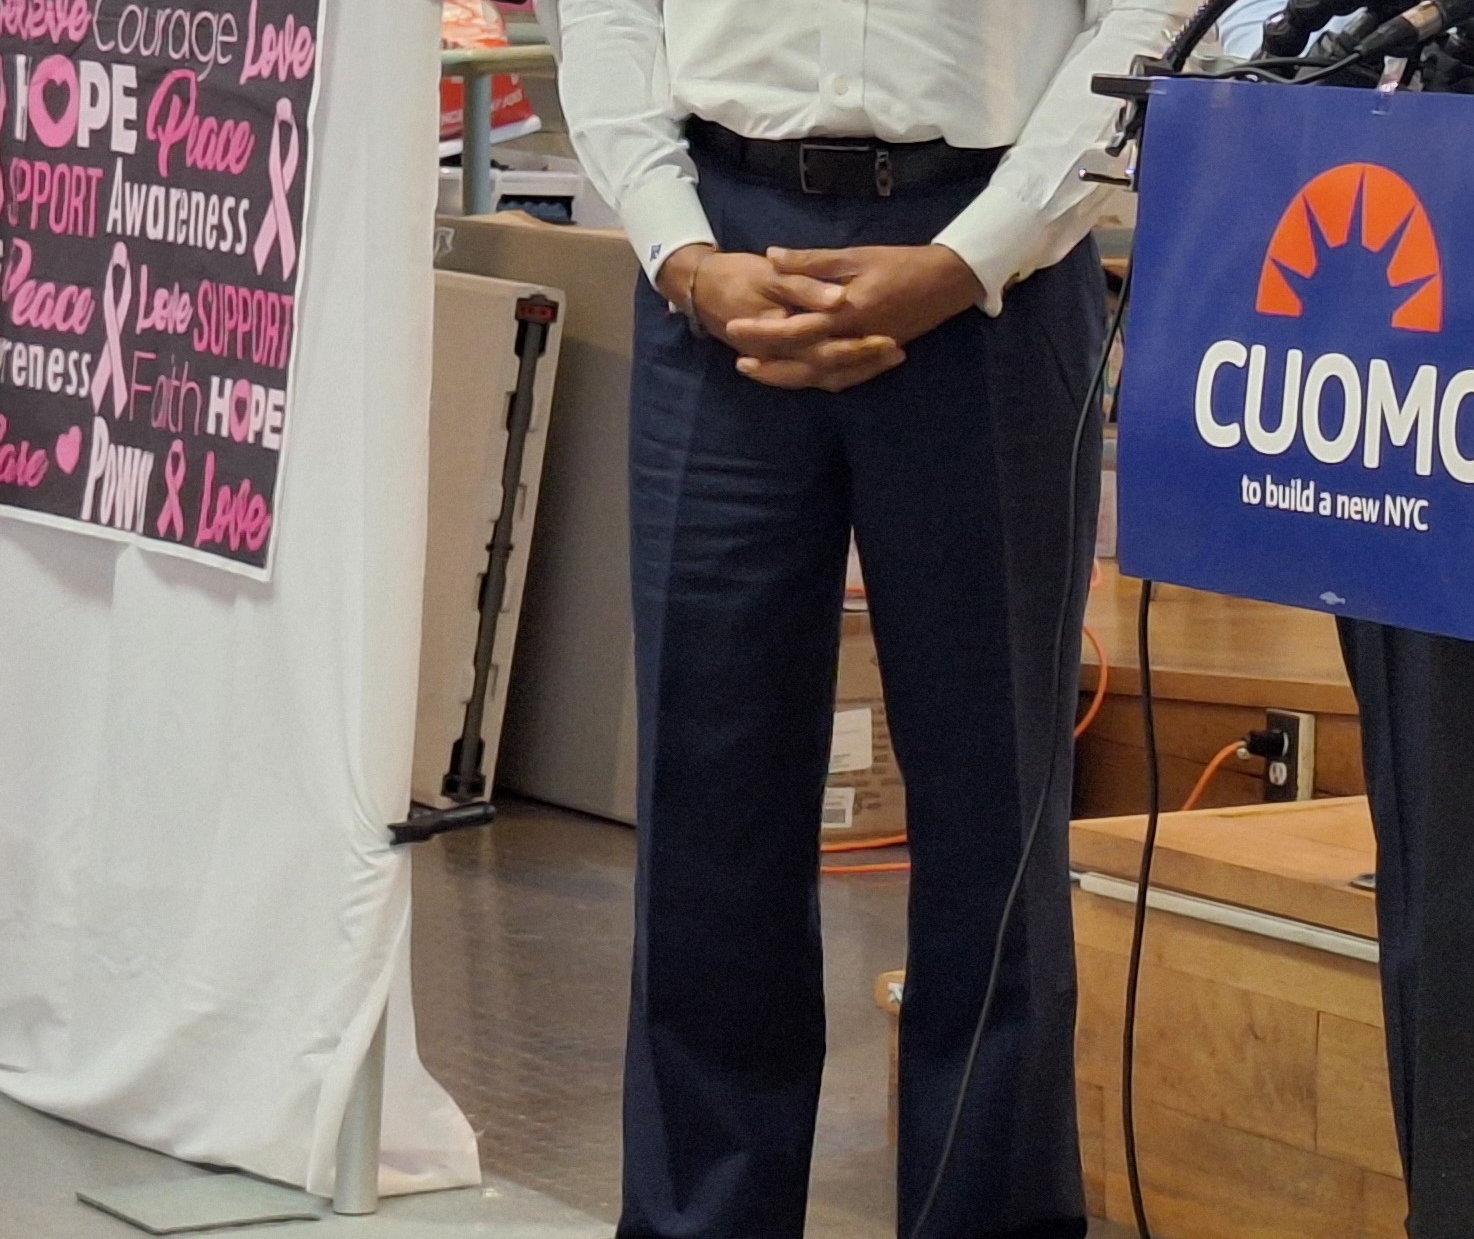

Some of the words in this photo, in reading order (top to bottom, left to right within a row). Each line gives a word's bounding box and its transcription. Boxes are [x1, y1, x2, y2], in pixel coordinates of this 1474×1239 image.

[15, 54, 138, 155] HOPE
[106, 157, 250, 255] Awareness
[135, 264, 194, 335] Love
[193, 279, 294, 370] SUPPORT
[206, 375, 285, 451] HOPE
[194, 450, 272, 552] Love
[1242, 474, 1262, 505] to
[1265, 474, 1315, 513] build
[1319, 491, 1331, 516] a
[1336, 493, 1380, 524] new
[1384, 494, 1429, 531] NYC
